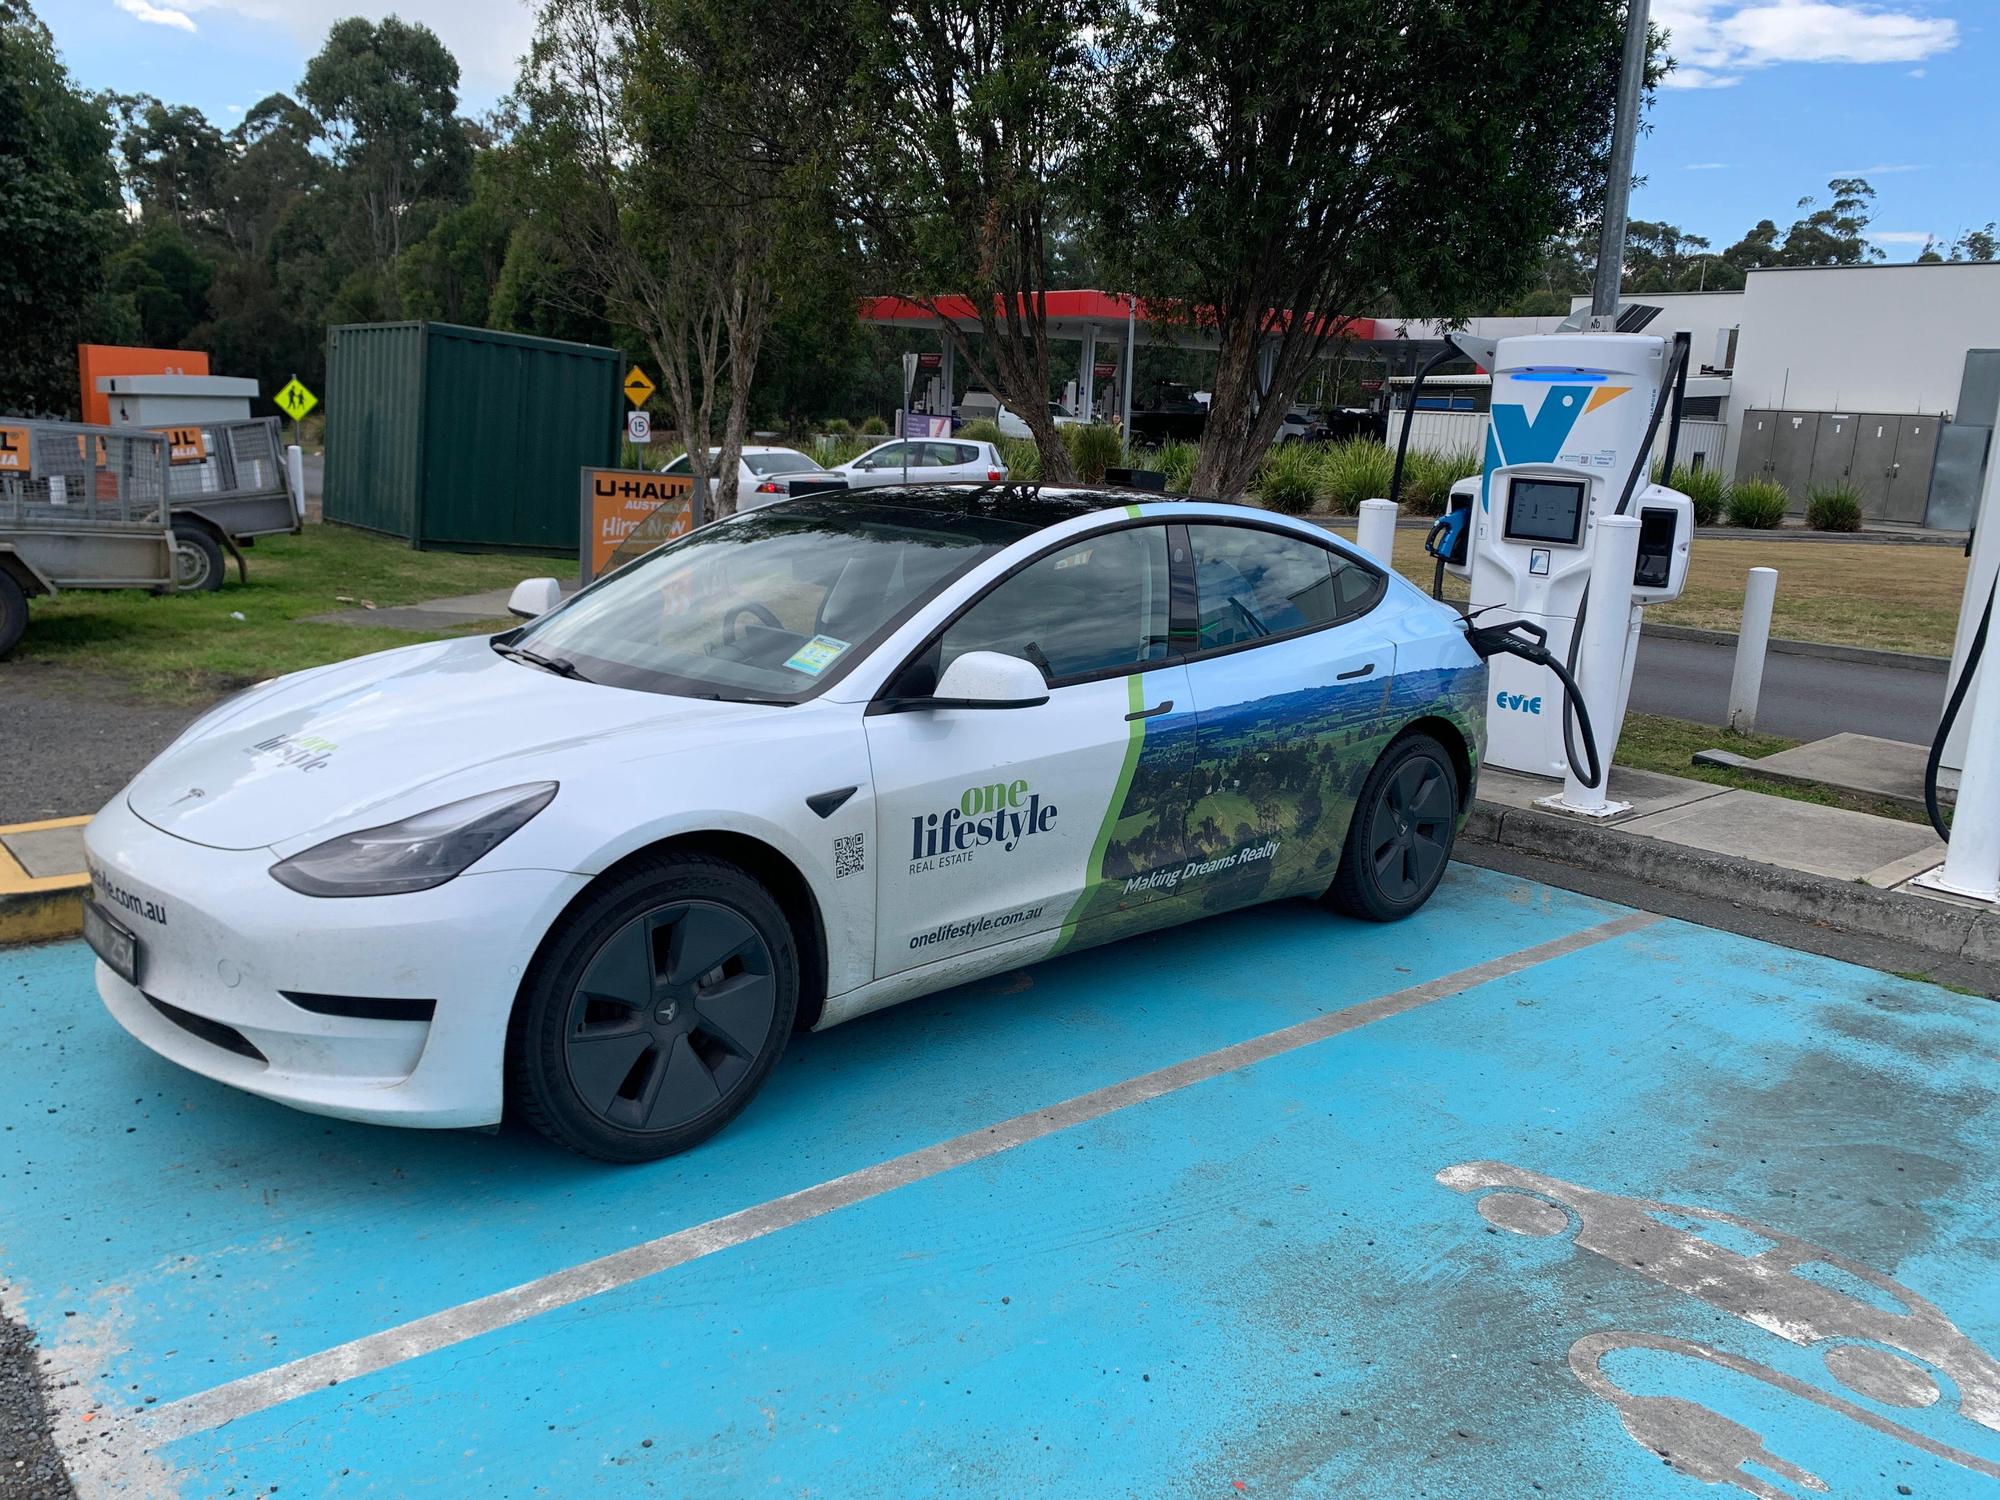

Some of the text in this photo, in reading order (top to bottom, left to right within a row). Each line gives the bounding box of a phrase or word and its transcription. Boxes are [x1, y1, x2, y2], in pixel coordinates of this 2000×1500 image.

[1591, 319, 1601, 329] NO
[634, 421, 645, 433] 15
[961, 779, 1028, 817] one
[910, 794, 1058, 861] lifestyle
[909, 851, 974, 875] REAL ESTATE
[1123, 841, 1281, 895] Making Dreams Realty
[909, 906, 1043, 949] onelifestyle.com.au
